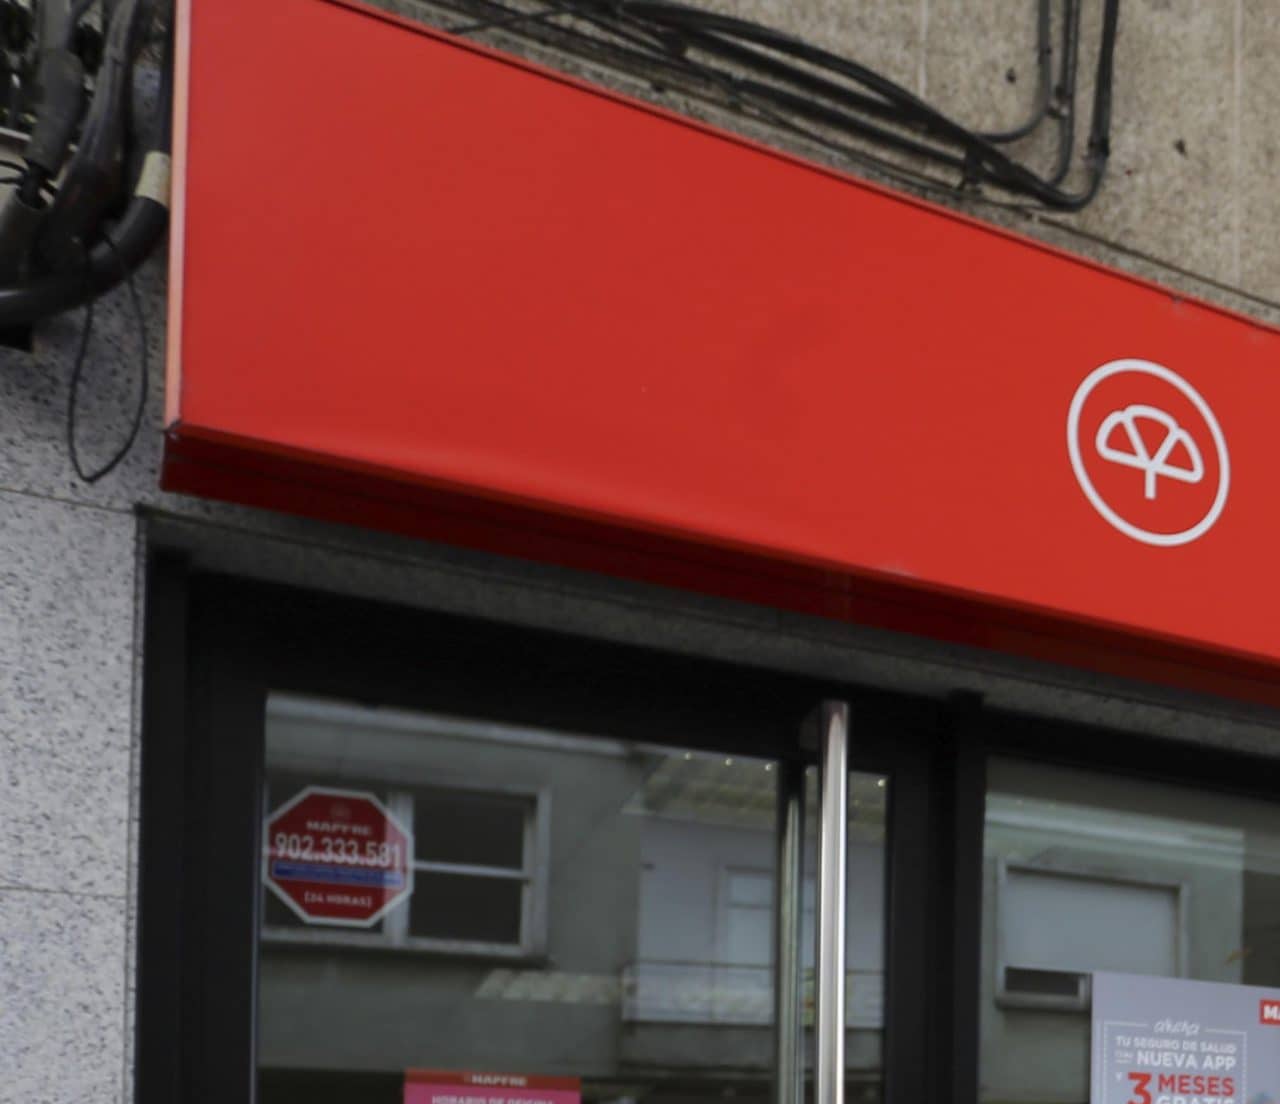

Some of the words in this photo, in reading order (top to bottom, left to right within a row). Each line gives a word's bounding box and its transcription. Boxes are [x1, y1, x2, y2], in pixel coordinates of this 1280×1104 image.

[1136, 1049, 1199, 1071] NUEVA
[1202, 1054, 1237, 1072] APP
[1157, 1072, 1236, 1098] MESES
